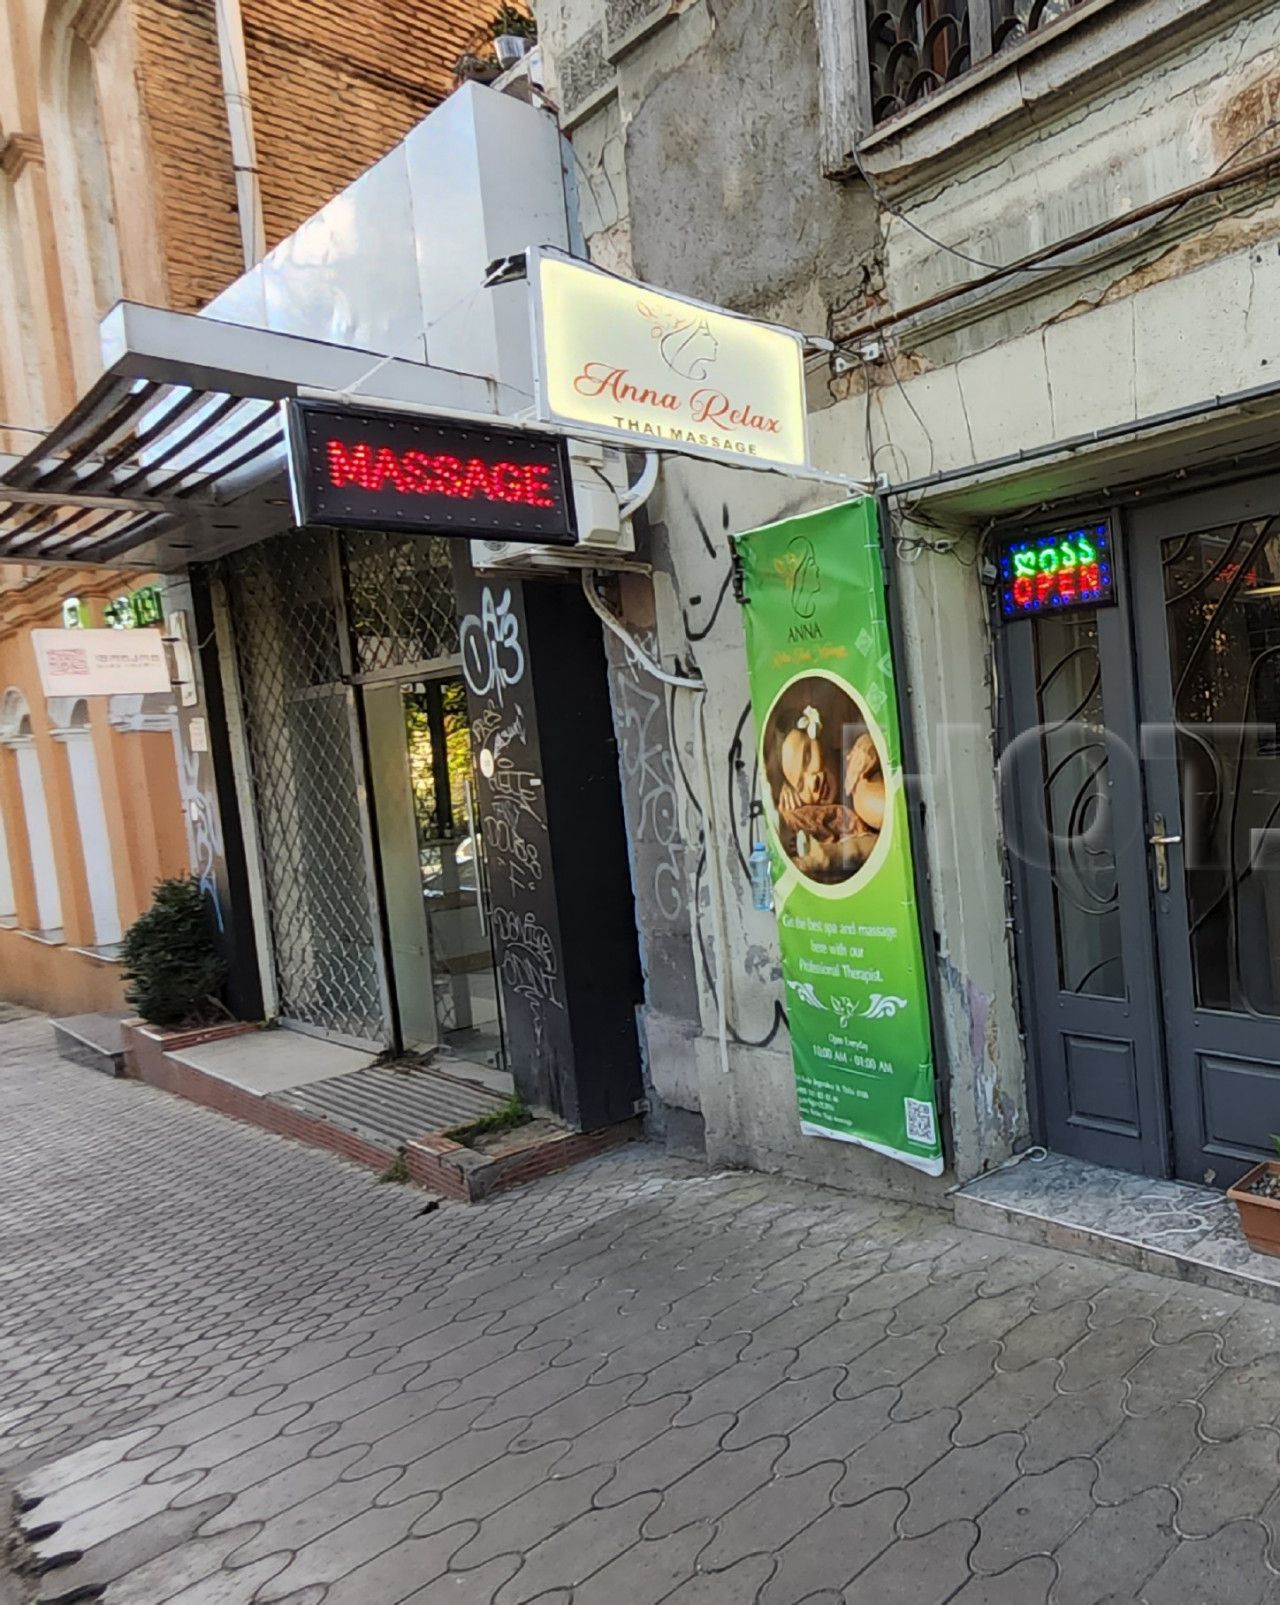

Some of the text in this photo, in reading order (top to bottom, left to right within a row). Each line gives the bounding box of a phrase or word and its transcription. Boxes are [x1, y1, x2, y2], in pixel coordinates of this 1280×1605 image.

[573, 361, 783, 434] Anna Relax
[613, 415, 758, 456] THAI MASSAGE
[325, 438, 556, 508] MASSAGE
[1013, 562, 1101, 606] OPEN
[787, 621, 824, 644] ANNA
